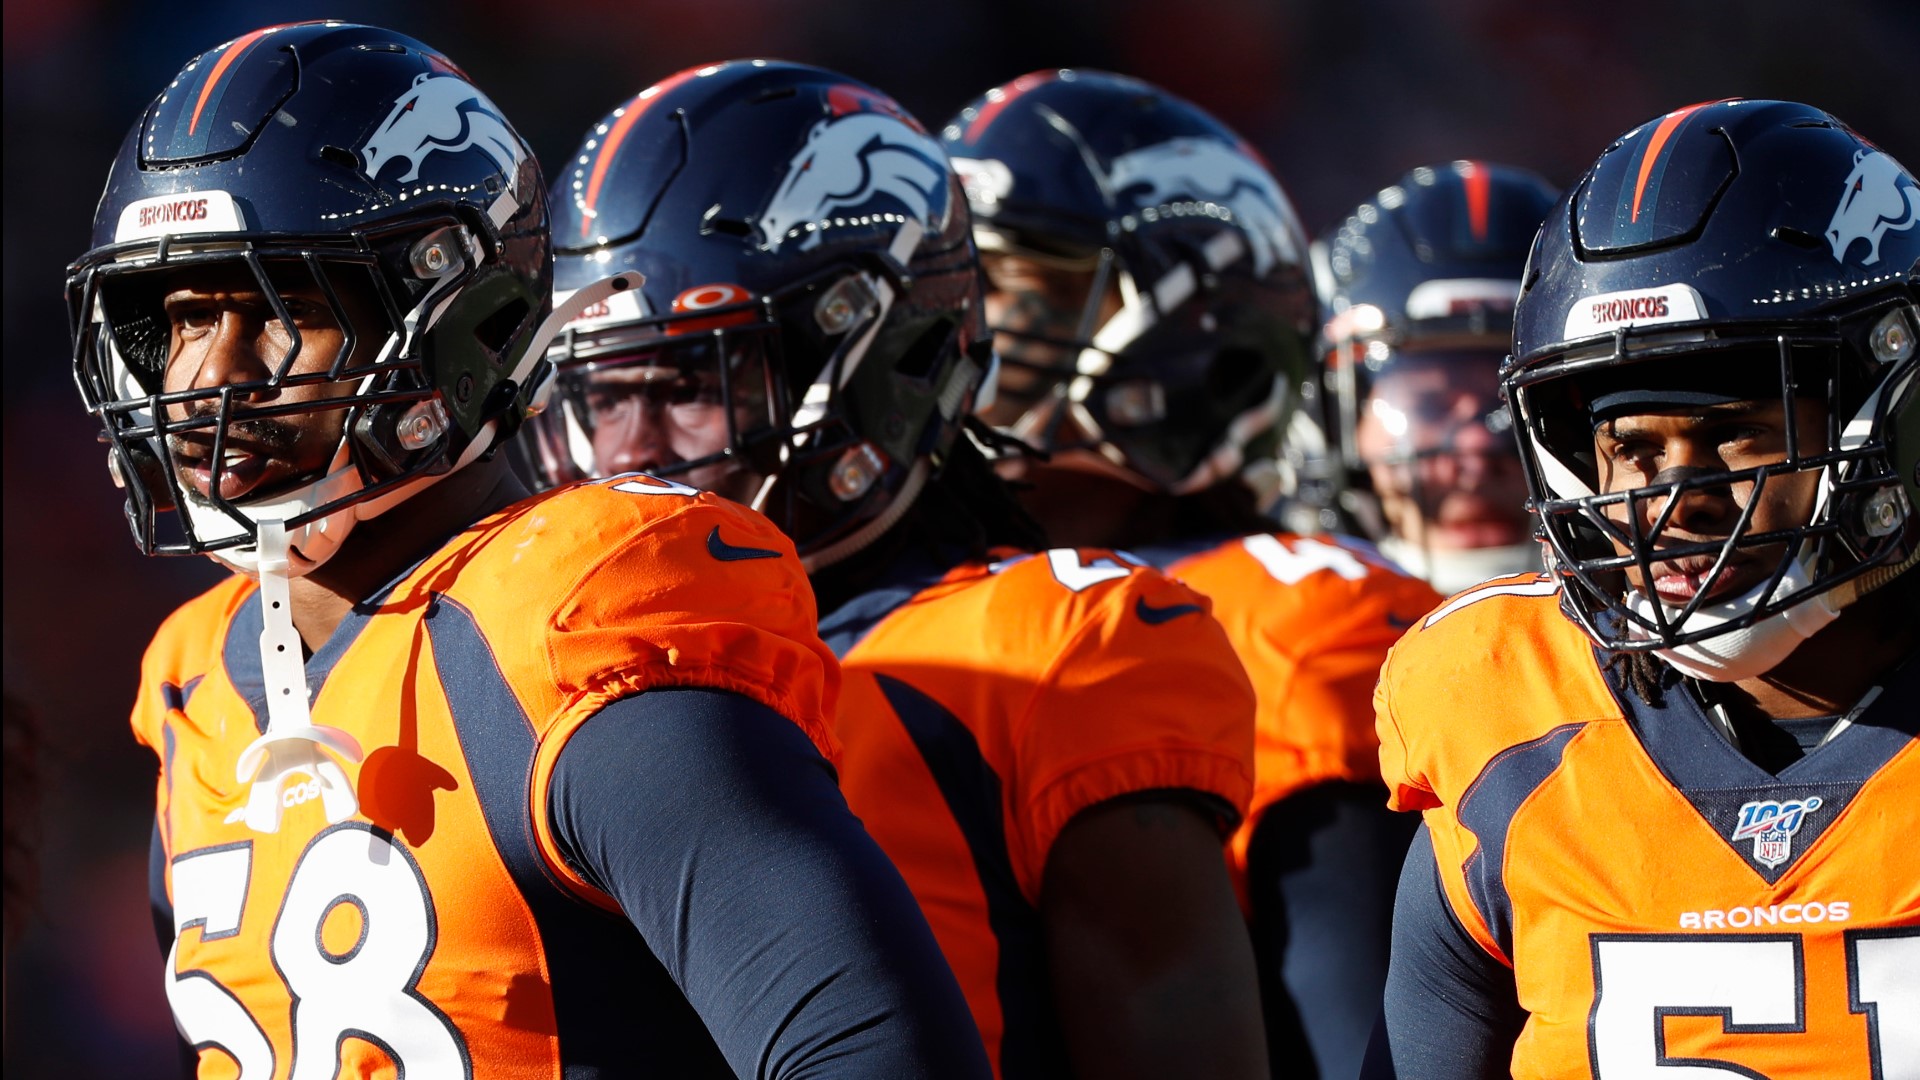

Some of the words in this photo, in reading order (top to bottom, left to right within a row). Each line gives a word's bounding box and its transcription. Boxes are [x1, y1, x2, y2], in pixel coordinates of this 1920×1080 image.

[139, 199, 208, 227] BRONCOS
[1592, 295, 1669, 324] BRONCOS
[1762, 842, 1783, 859] NFL
[1679, 902, 1850, 930] BRONCOS
[165, 821, 473, 1080] 58
[1588, 926, 1920, 1080] 5
